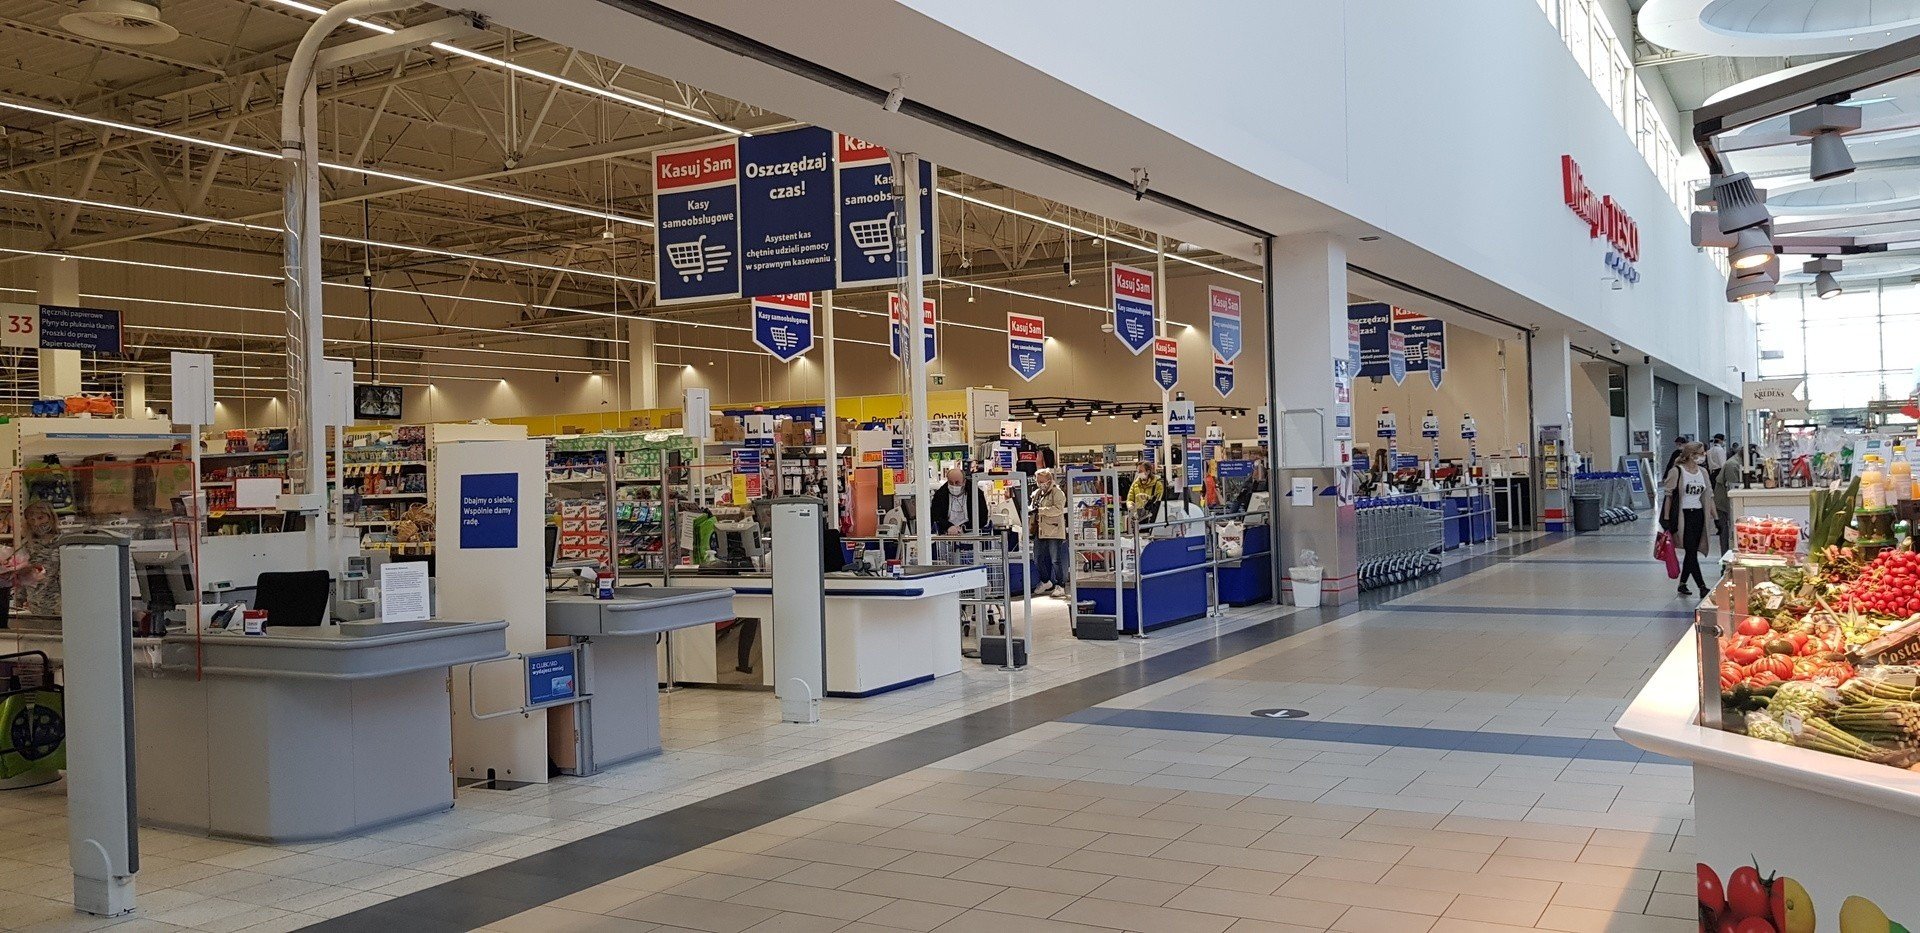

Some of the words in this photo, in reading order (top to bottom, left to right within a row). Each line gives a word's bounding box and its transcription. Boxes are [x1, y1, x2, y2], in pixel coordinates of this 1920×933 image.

[844, 135, 888, 151] Kas
[661, 159, 700, 179] Kasuj
[703, 158, 732, 174] Sam
[745, 152, 827, 179] Oszczędzaj
[874, 174, 894, 186] Kas
[769, 180, 806, 200] czas!
[845, 187, 928, 206] samoobswe
[687, 200, 710, 211] Kasy
[662, 212, 734, 229] samoobsługowe
[1603, 195, 1639, 262] TESCO
[765, 232, 798, 244] Asystent
[798, 231, 812, 239] kas
[746, 248, 775, 259] chętnie
[775, 245, 800, 255] udzieli
[801, 242, 830, 254] pomocy
[753, 259, 792, 271] sprawnym
[792, 254, 831, 266] kasowaniu
[1116, 274, 1136, 294] Kasuj
[1136, 278, 1151, 294] Sam
[1212, 294, 1228, 311] Kasuj
[1228, 299, 1239, 312] Sam
[41, 308, 70, 317] Ręczniki
[71, 310, 104, 319] papierowe
[758, 310, 771, 322] Kasy
[771, 313, 809, 325] samoobsługowe
[8, 315, 34, 334] 33
[41, 318, 60, 327] Płyny
[1011, 320, 1029, 336] Kasuj
[1029, 323, 1042, 335] Sam
[41, 329, 67, 337] Proszki
[67, 330, 76, 338] do
[1360, 326, 1376, 335] zas!
[63, 341, 97, 350] toaletowy
[933, 411, 967, 421] Obniżk
[984, 404, 999, 418] F&F
[463, 497, 487, 506] Dbajmy
[493, 495, 515, 504] siebie.
[463, 507, 493, 516] Wspólnie
[493, 507, 512, 515] damy
[463, 517, 480, 526] radę.
[1878, 641, 1920, 666] Costa
